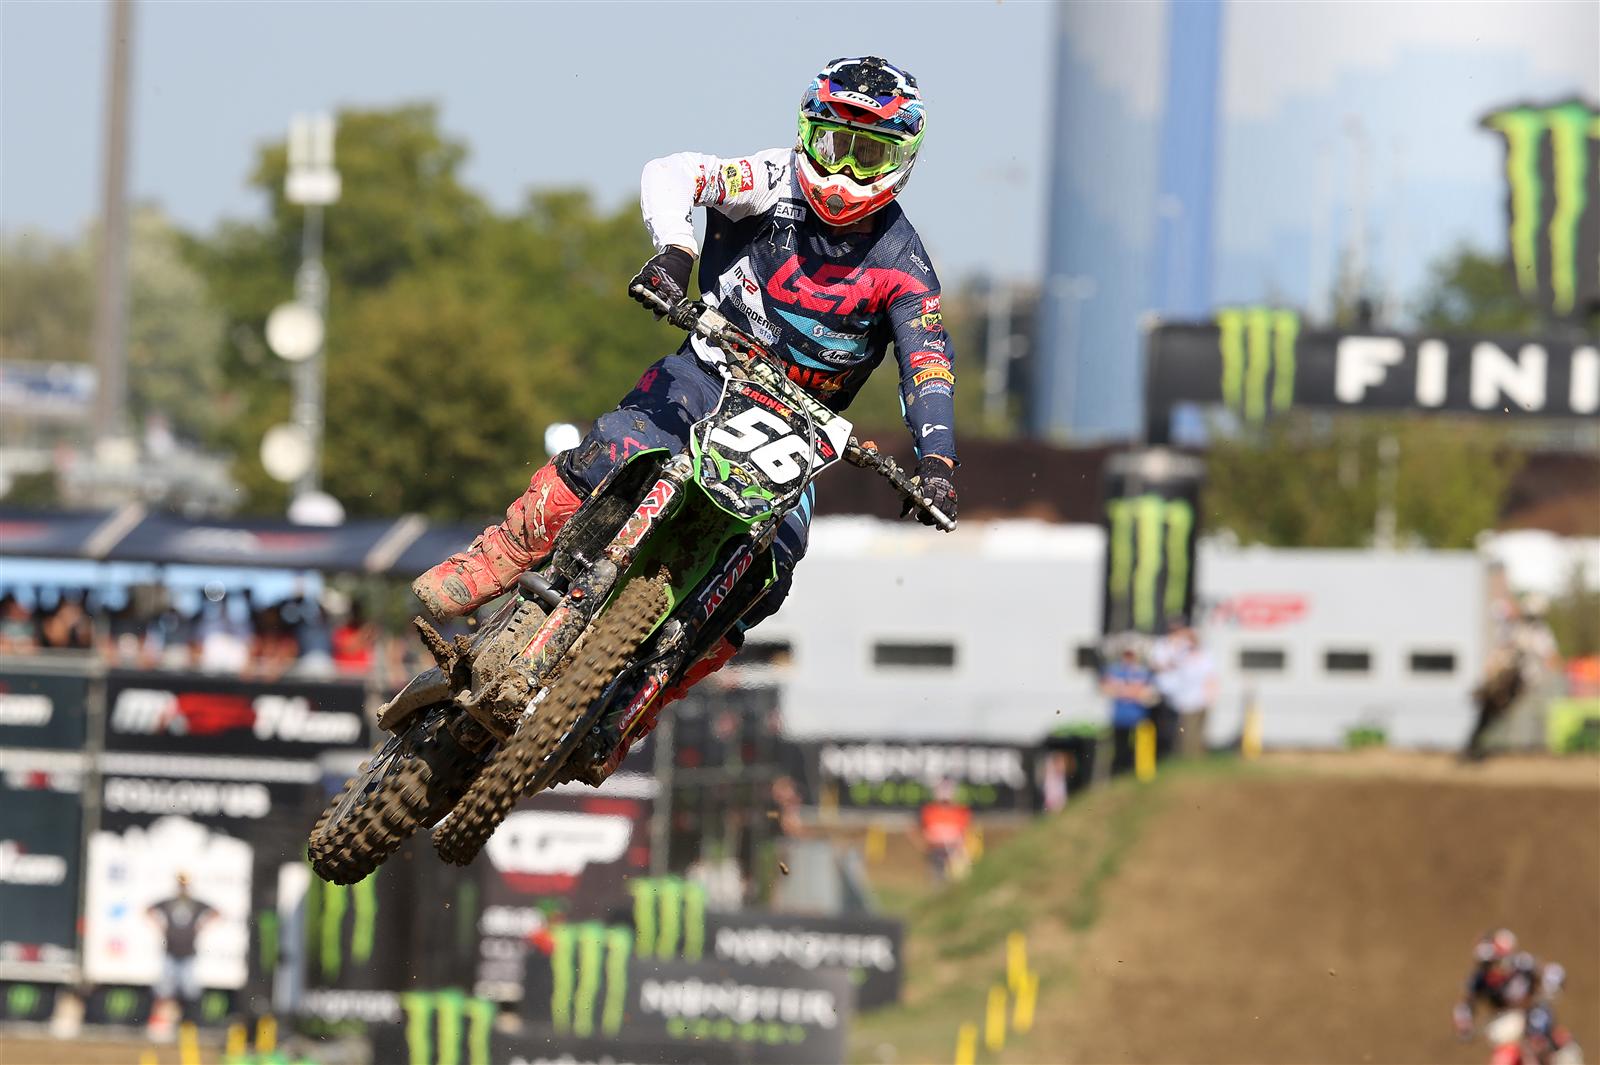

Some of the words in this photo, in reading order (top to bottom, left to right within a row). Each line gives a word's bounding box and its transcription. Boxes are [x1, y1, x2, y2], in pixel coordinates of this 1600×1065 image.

[734, 266, 759, 295] MX2
[1335, 335, 1600, 414] FINI
[710, 406, 825, 485] 56
